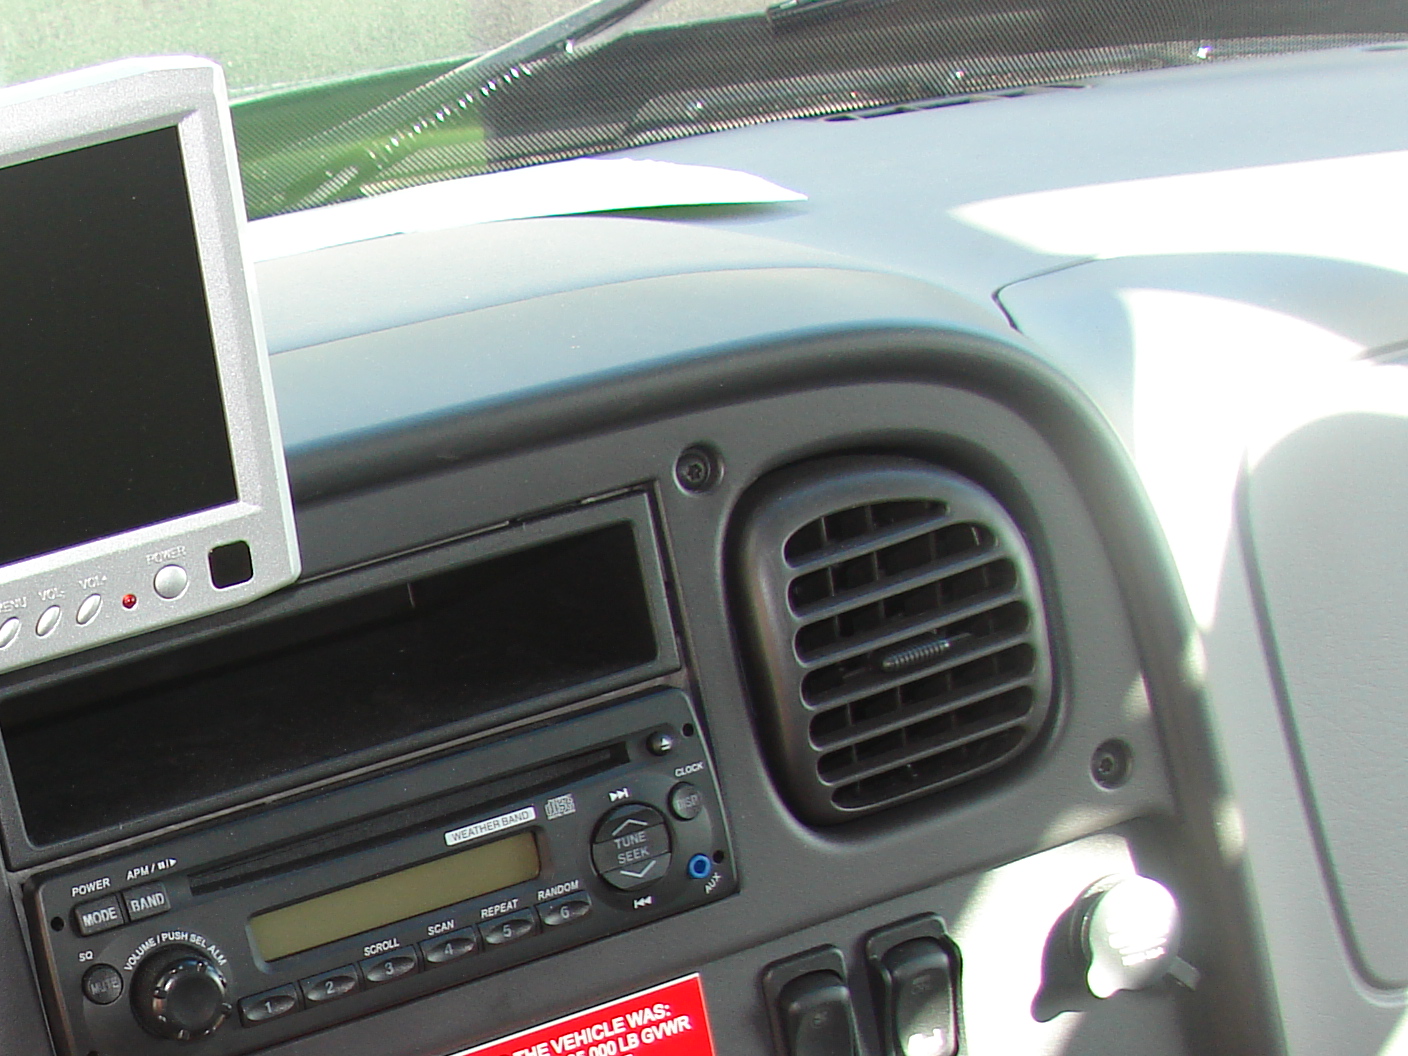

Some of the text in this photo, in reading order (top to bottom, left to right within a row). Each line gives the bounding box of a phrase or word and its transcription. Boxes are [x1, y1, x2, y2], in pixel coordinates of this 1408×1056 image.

[674, 761, 704, 777] CLOCK
[451, 811, 530, 842] WEATHER BAND
[614, 831, 647, 849] TUNE
[617, 847, 650, 864] SEEK
[127, 864, 150, 881] APM
[71, 877, 111, 897] POWER
[538, 879, 579, 900] RANDOM
[704, 872, 722, 894] AUX
[130, 892, 165, 912] BAND
[480, 899, 519, 919] REPEAT
[82, 906, 118, 928] MODE
[561, 906, 570, 919] 6
[427, 919, 455, 937] SCAN
[503, 925, 512, 938] 5
[78, 950, 94, 963] SQ
[124, 931, 227, 972] VOLUME PUSH SEL ALM
[363, 937, 400, 957] SCROLL
[91, 976, 121, 996] MUTE
[325, 981, 335, 995] 2
[550, 1017, 626, 1054] VEHICLE
[626, 1003, 672, 1029] WAS:
[618, 1033, 640, 1052] LB
[641, 1015, 692, 1045] GVWR
